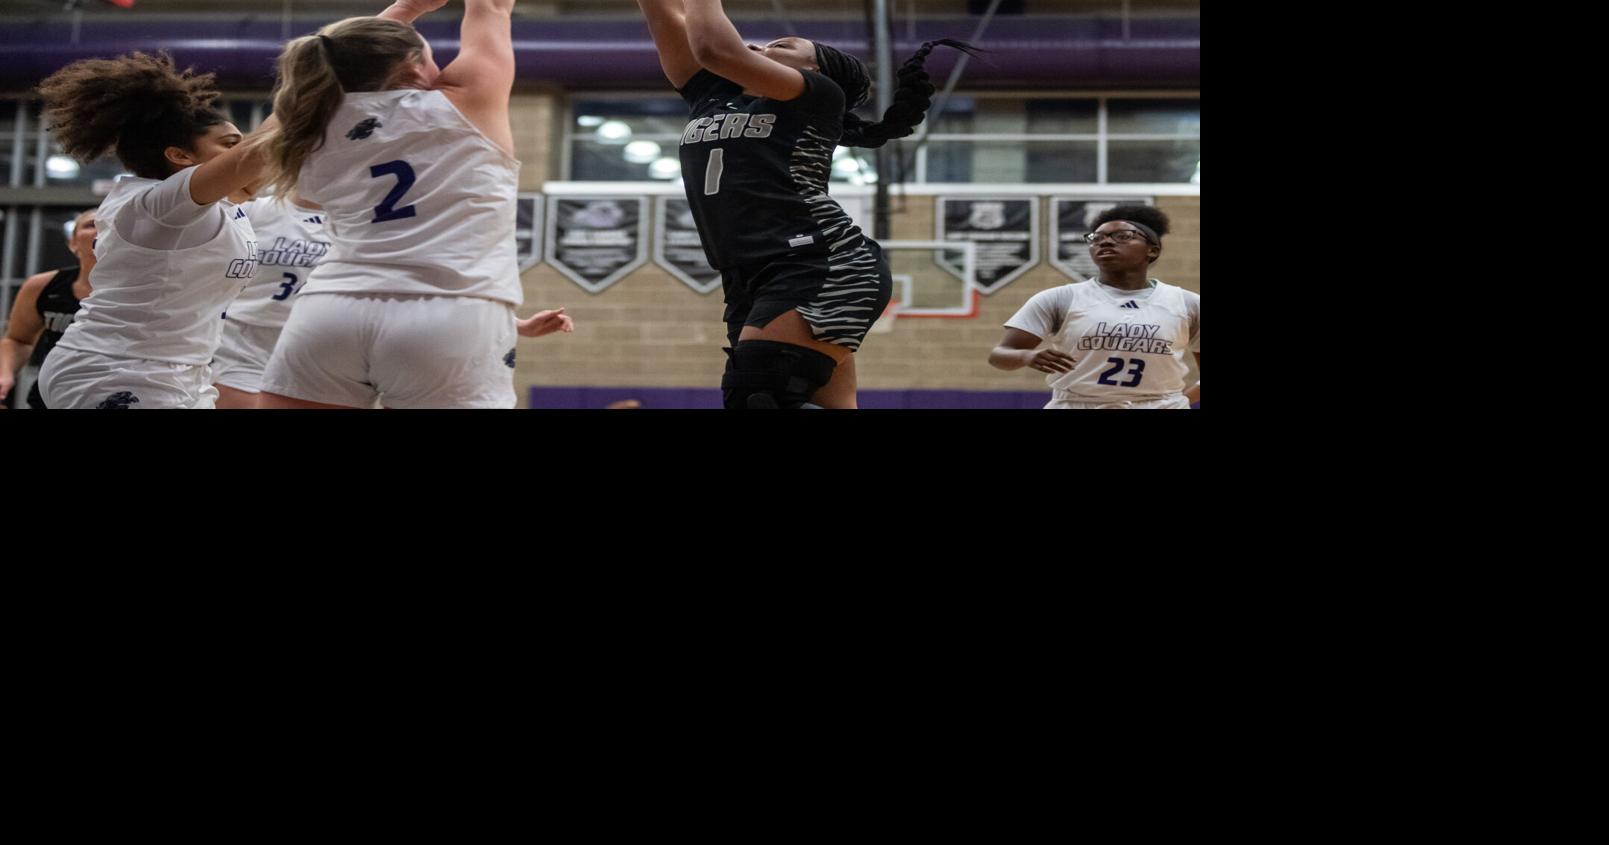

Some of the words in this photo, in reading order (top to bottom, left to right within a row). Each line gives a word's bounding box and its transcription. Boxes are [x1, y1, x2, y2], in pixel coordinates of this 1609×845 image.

[680, 113, 777, 146] IGERS
[704, 148, 724, 196] 1
[370, 159, 417, 224] 2
[271, 272, 307, 301] 3
[1077, 335, 1174, 356] COUGARS
[1096, 321, 1161, 340] LADY
[1097, 356, 1146, 388] 23
